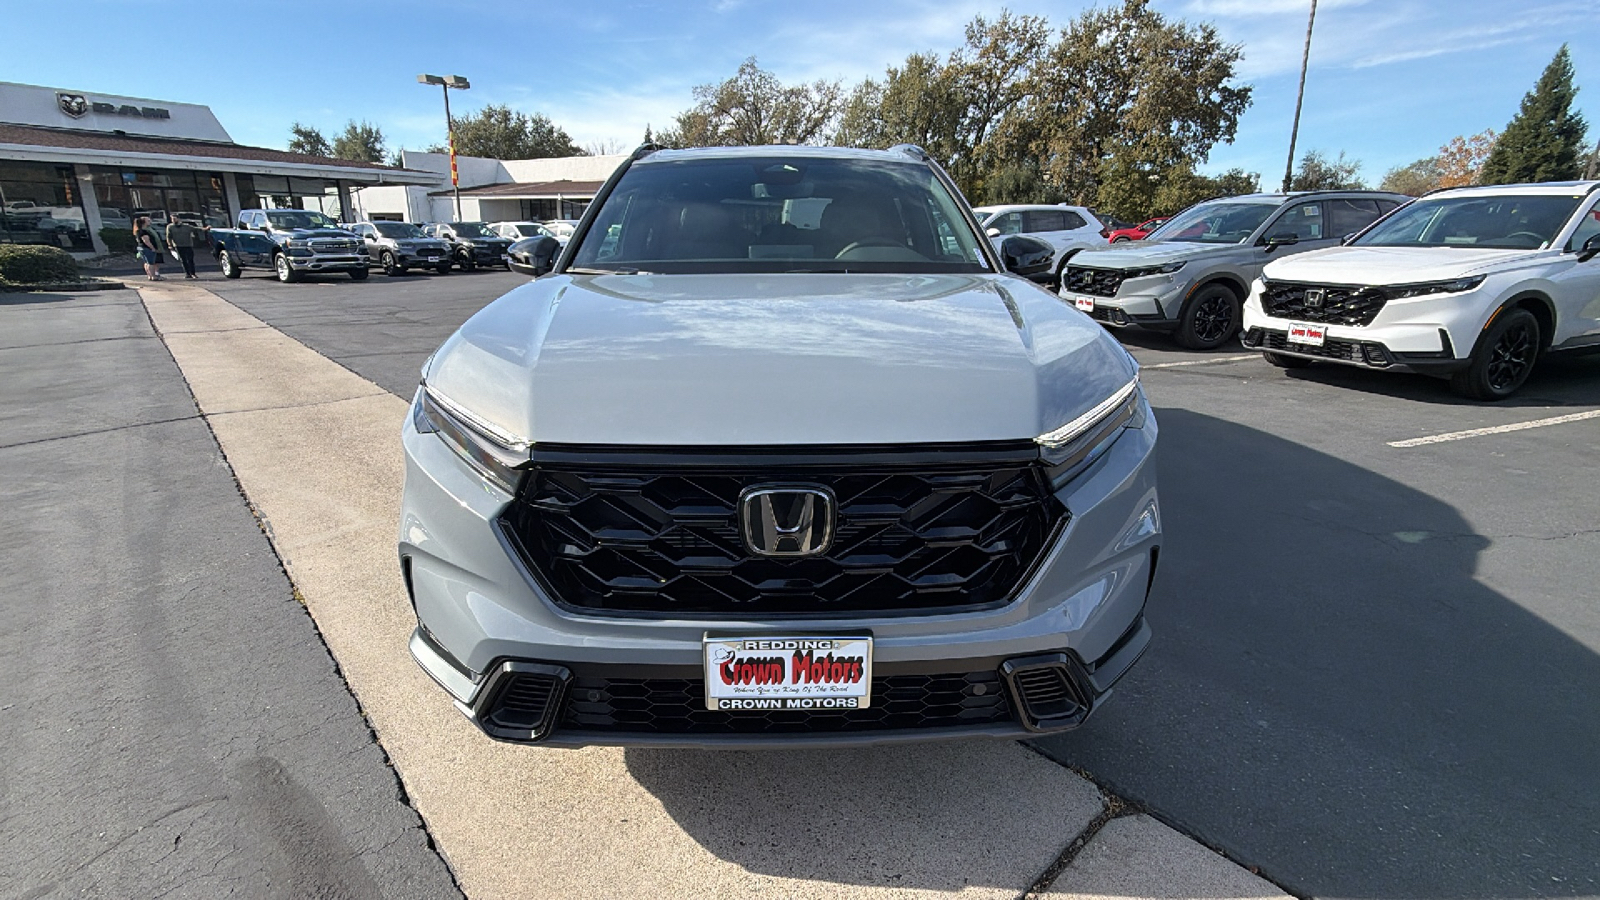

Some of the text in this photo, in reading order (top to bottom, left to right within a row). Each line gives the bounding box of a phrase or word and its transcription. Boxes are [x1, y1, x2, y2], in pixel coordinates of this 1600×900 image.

[92, 101, 171, 119] RAM
[744, 640, 832, 650] REDDING
[719, 649, 864, 686] Crown Motors
[719, 698, 858, 709] CROWN MOTORS
